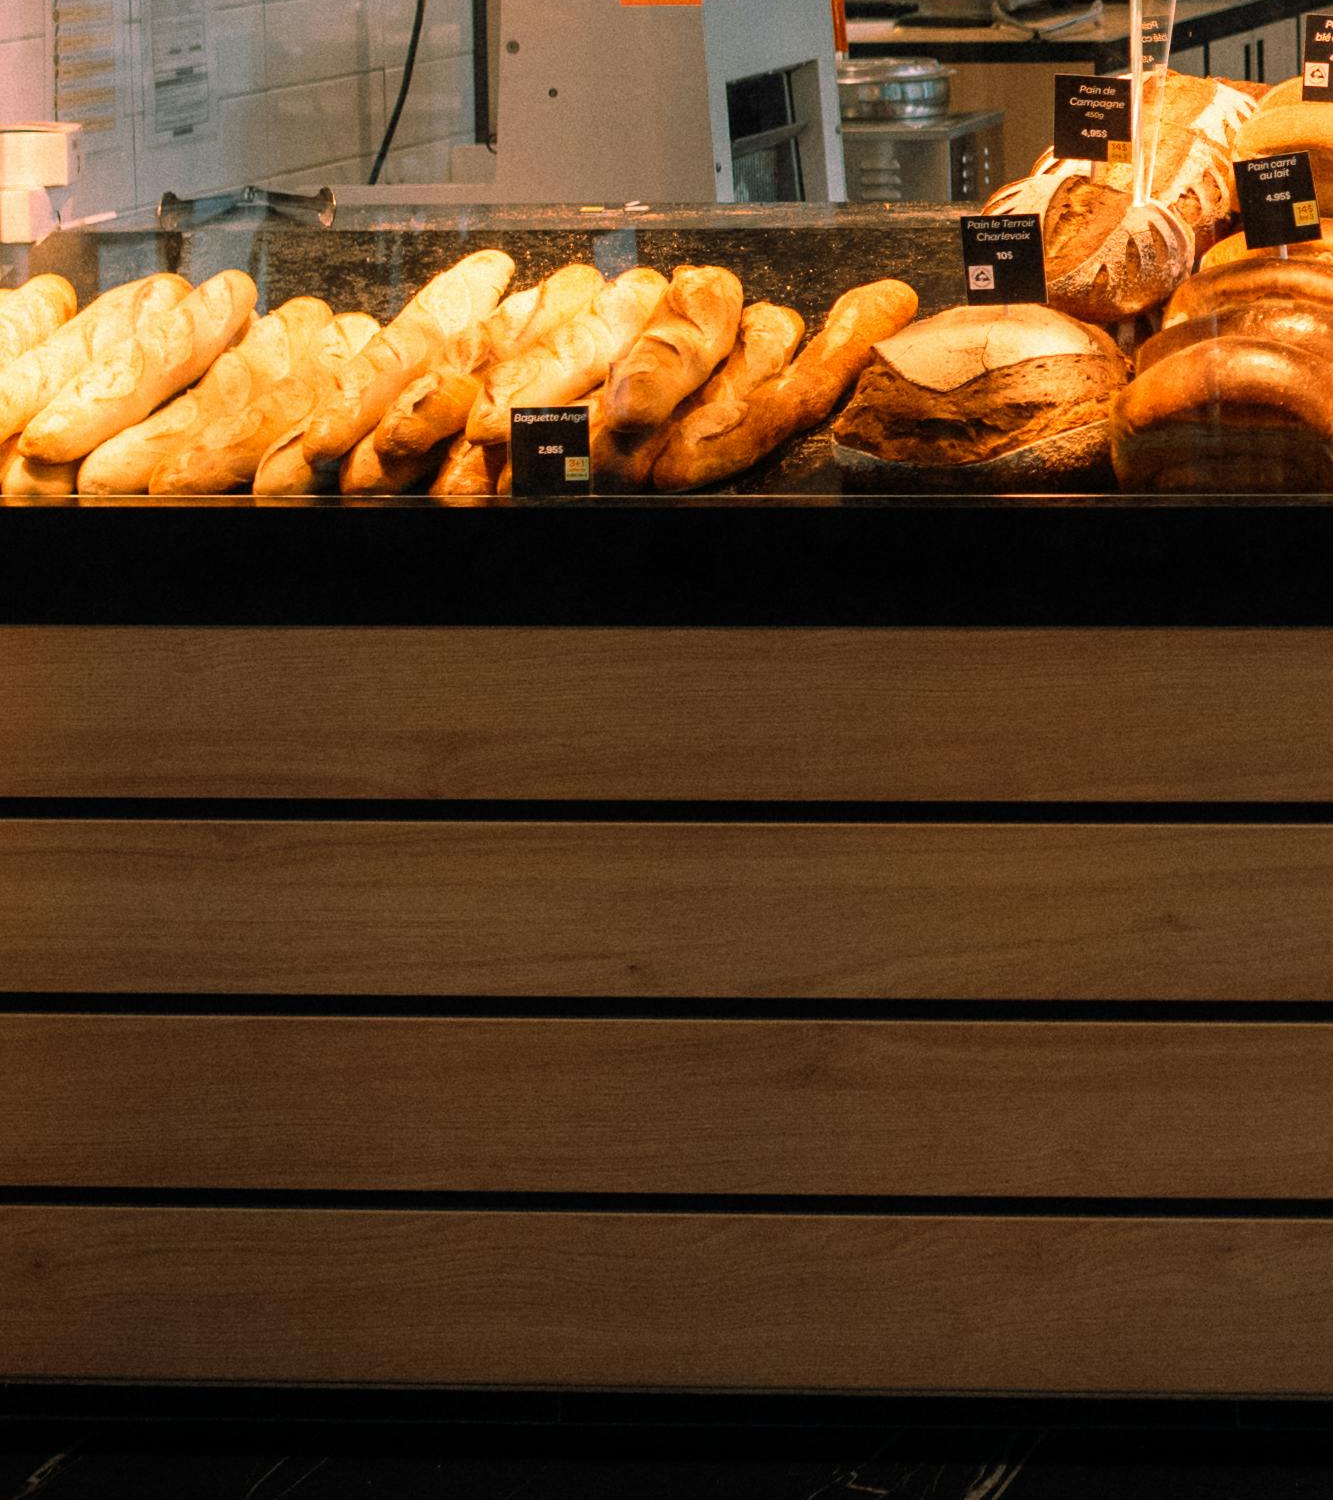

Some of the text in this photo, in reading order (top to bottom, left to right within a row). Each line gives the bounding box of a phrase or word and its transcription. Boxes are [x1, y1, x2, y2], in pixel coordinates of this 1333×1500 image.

[1315, 32, 1331, 42] blé
[1080, 85, 1116, 95] Pain de
[1069, 97, 1125, 109] Campagne
[1248, 156, 1297, 172] Pain carré
[1260, 168, 1290, 180] au lait
[967, 220, 989, 230] Pain
[1002, 218, 1035, 228] Terroir
[976, 231, 1030, 241] Charlevoix
[996, 251, 1013, 260] 10$
[514, 412, 586, 424] Baguette Ange
